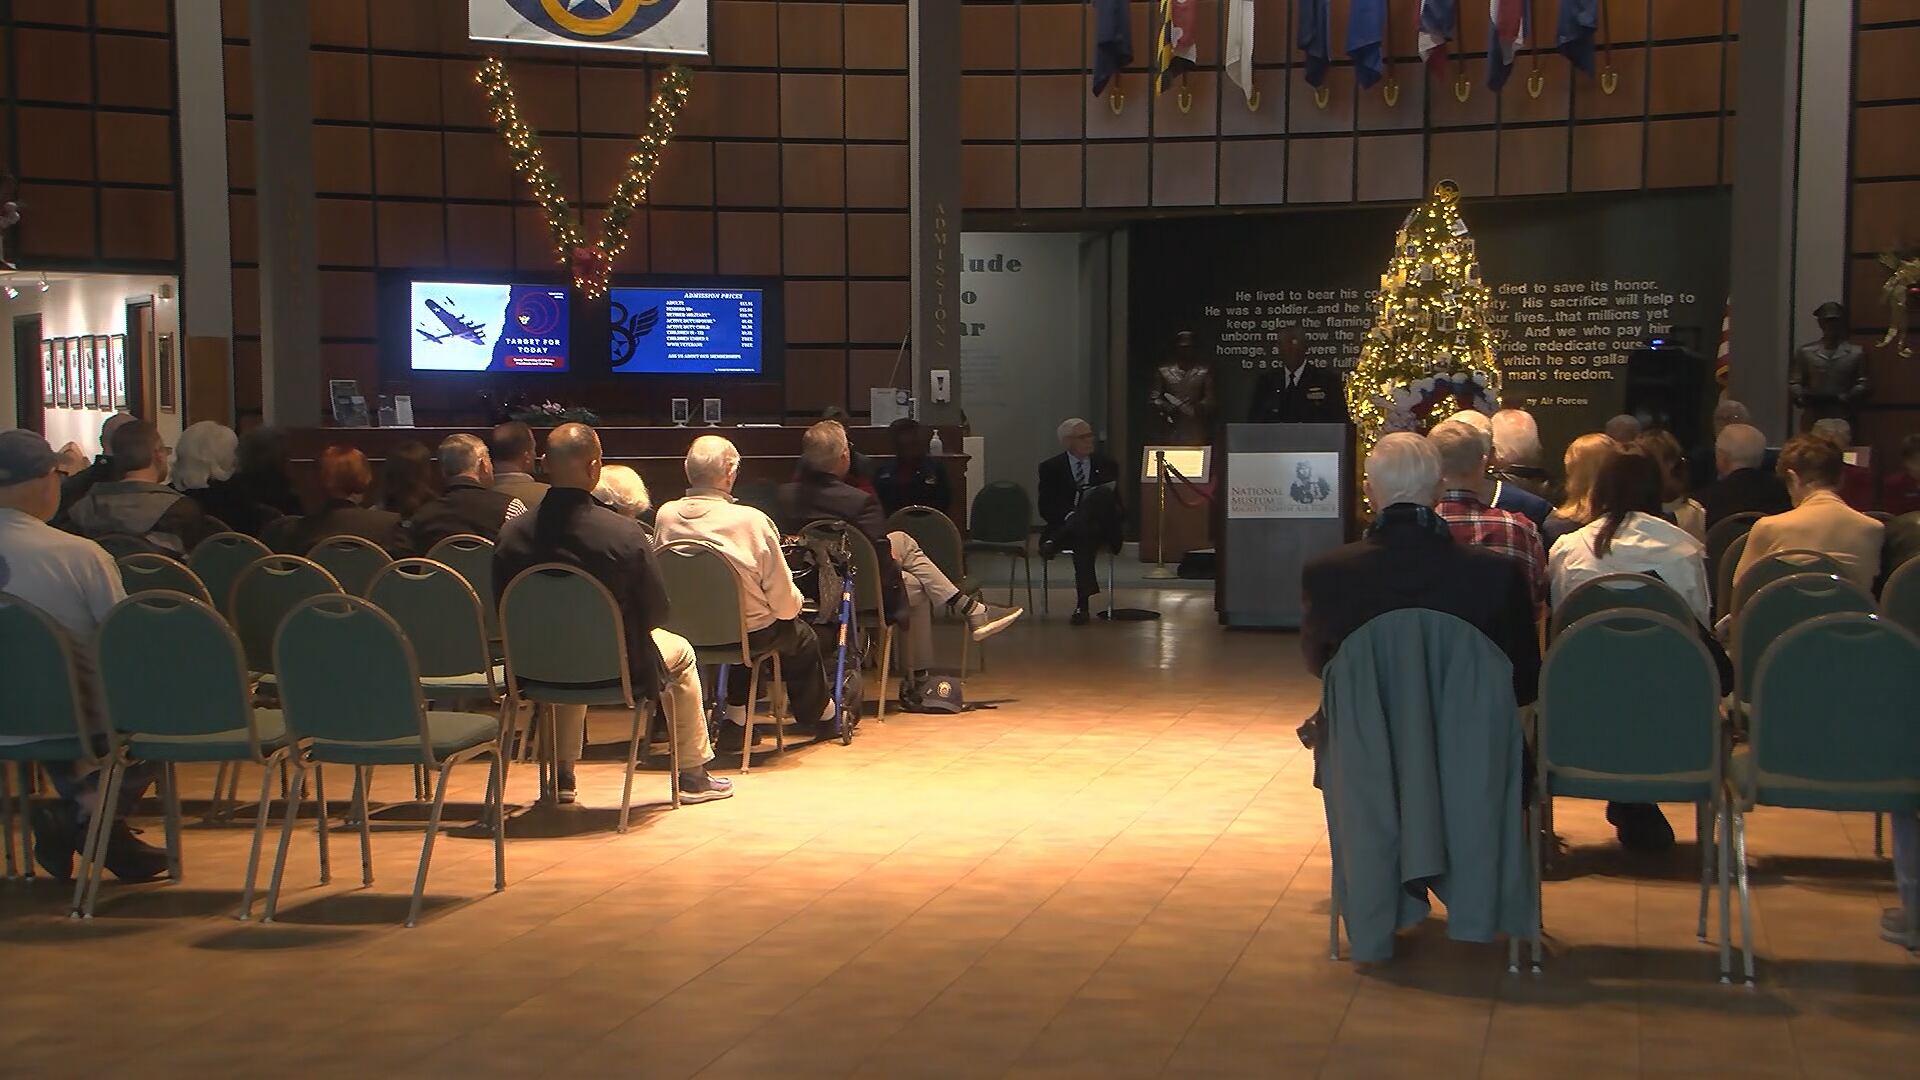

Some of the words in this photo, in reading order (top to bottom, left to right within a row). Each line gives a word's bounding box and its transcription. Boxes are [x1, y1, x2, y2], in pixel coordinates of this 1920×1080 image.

[960, 253, 1022, 273] lude
[961, 291, 977, 305] o
[1235, 291, 1252, 302] He
[1256, 290, 1284, 301] lived
[1289, 290, 1302, 301] to
[1307, 289, 1335, 300] bear
[1340, 288, 1359, 299] his
[1498, 283, 1527, 295] died
[1534, 283, 1547, 294] to
[1553, 283, 1585, 294] save
[1590, 281, 1609, 292] its
[1614, 280, 1658, 290] honor.
[1204, 306, 1221, 316] He
[1226, 307, 1249, 316] was
[1254, 307, 1262, 315] a
[1344, 302, 1360, 313] he
[1522, 297, 1544, 308] His
[1550, 295, 1608, 308] sacrifice
[1615, 293, 1638, 305] will
[1643, 293, 1674, 306] help
[1679, 292, 1695, 304] to
[1226, 319, 1256, 330] keep
[1261, 317, 1297, 330] aglow
[1301, 317, 1321, 328] the
[1326, 316, 1371, 329] flaming
[1587, 309, 1641, 321] millions
[1646, 308, 1670, 321] yet
[960, 320, 986, 337] ar
[1221, 331, 1262, 342] unborn
[1305, 332, 1329, 341] now
[1334, 330, 1354, 341] the
[1524, 325, 1551, 337] And
[1557, 328, 1576, 337] we
[1583, 325, 1611, 336] who
[1617, 326, 1642, 337] pay
[542, 338, 561, 346] FOR
[1216, 345, 1266, 357] homage,
[1342, 343, 1360, 354] his
[1534, 340, 1607, 352] rededicate
[517, 346, 548, 354] TODAY
[1241, 359, 1253, 369] to
[1259, 360, 1267, 369] a
[1503, 354, 1541, 366] which
[1547, 354, 1564, 366] he
[1570, 355, 1586, 366] so
[1508, 369, 1548, 381] man's
[1554, 368, 1615, 381] freedom.
[1540, 396, 1554, 406] Air
[1556, 396, 1589, 406] Forces
[1231, 487, 1284, 496] NATIONAL
[1231, 496, 1275, 505] MUSEUM
